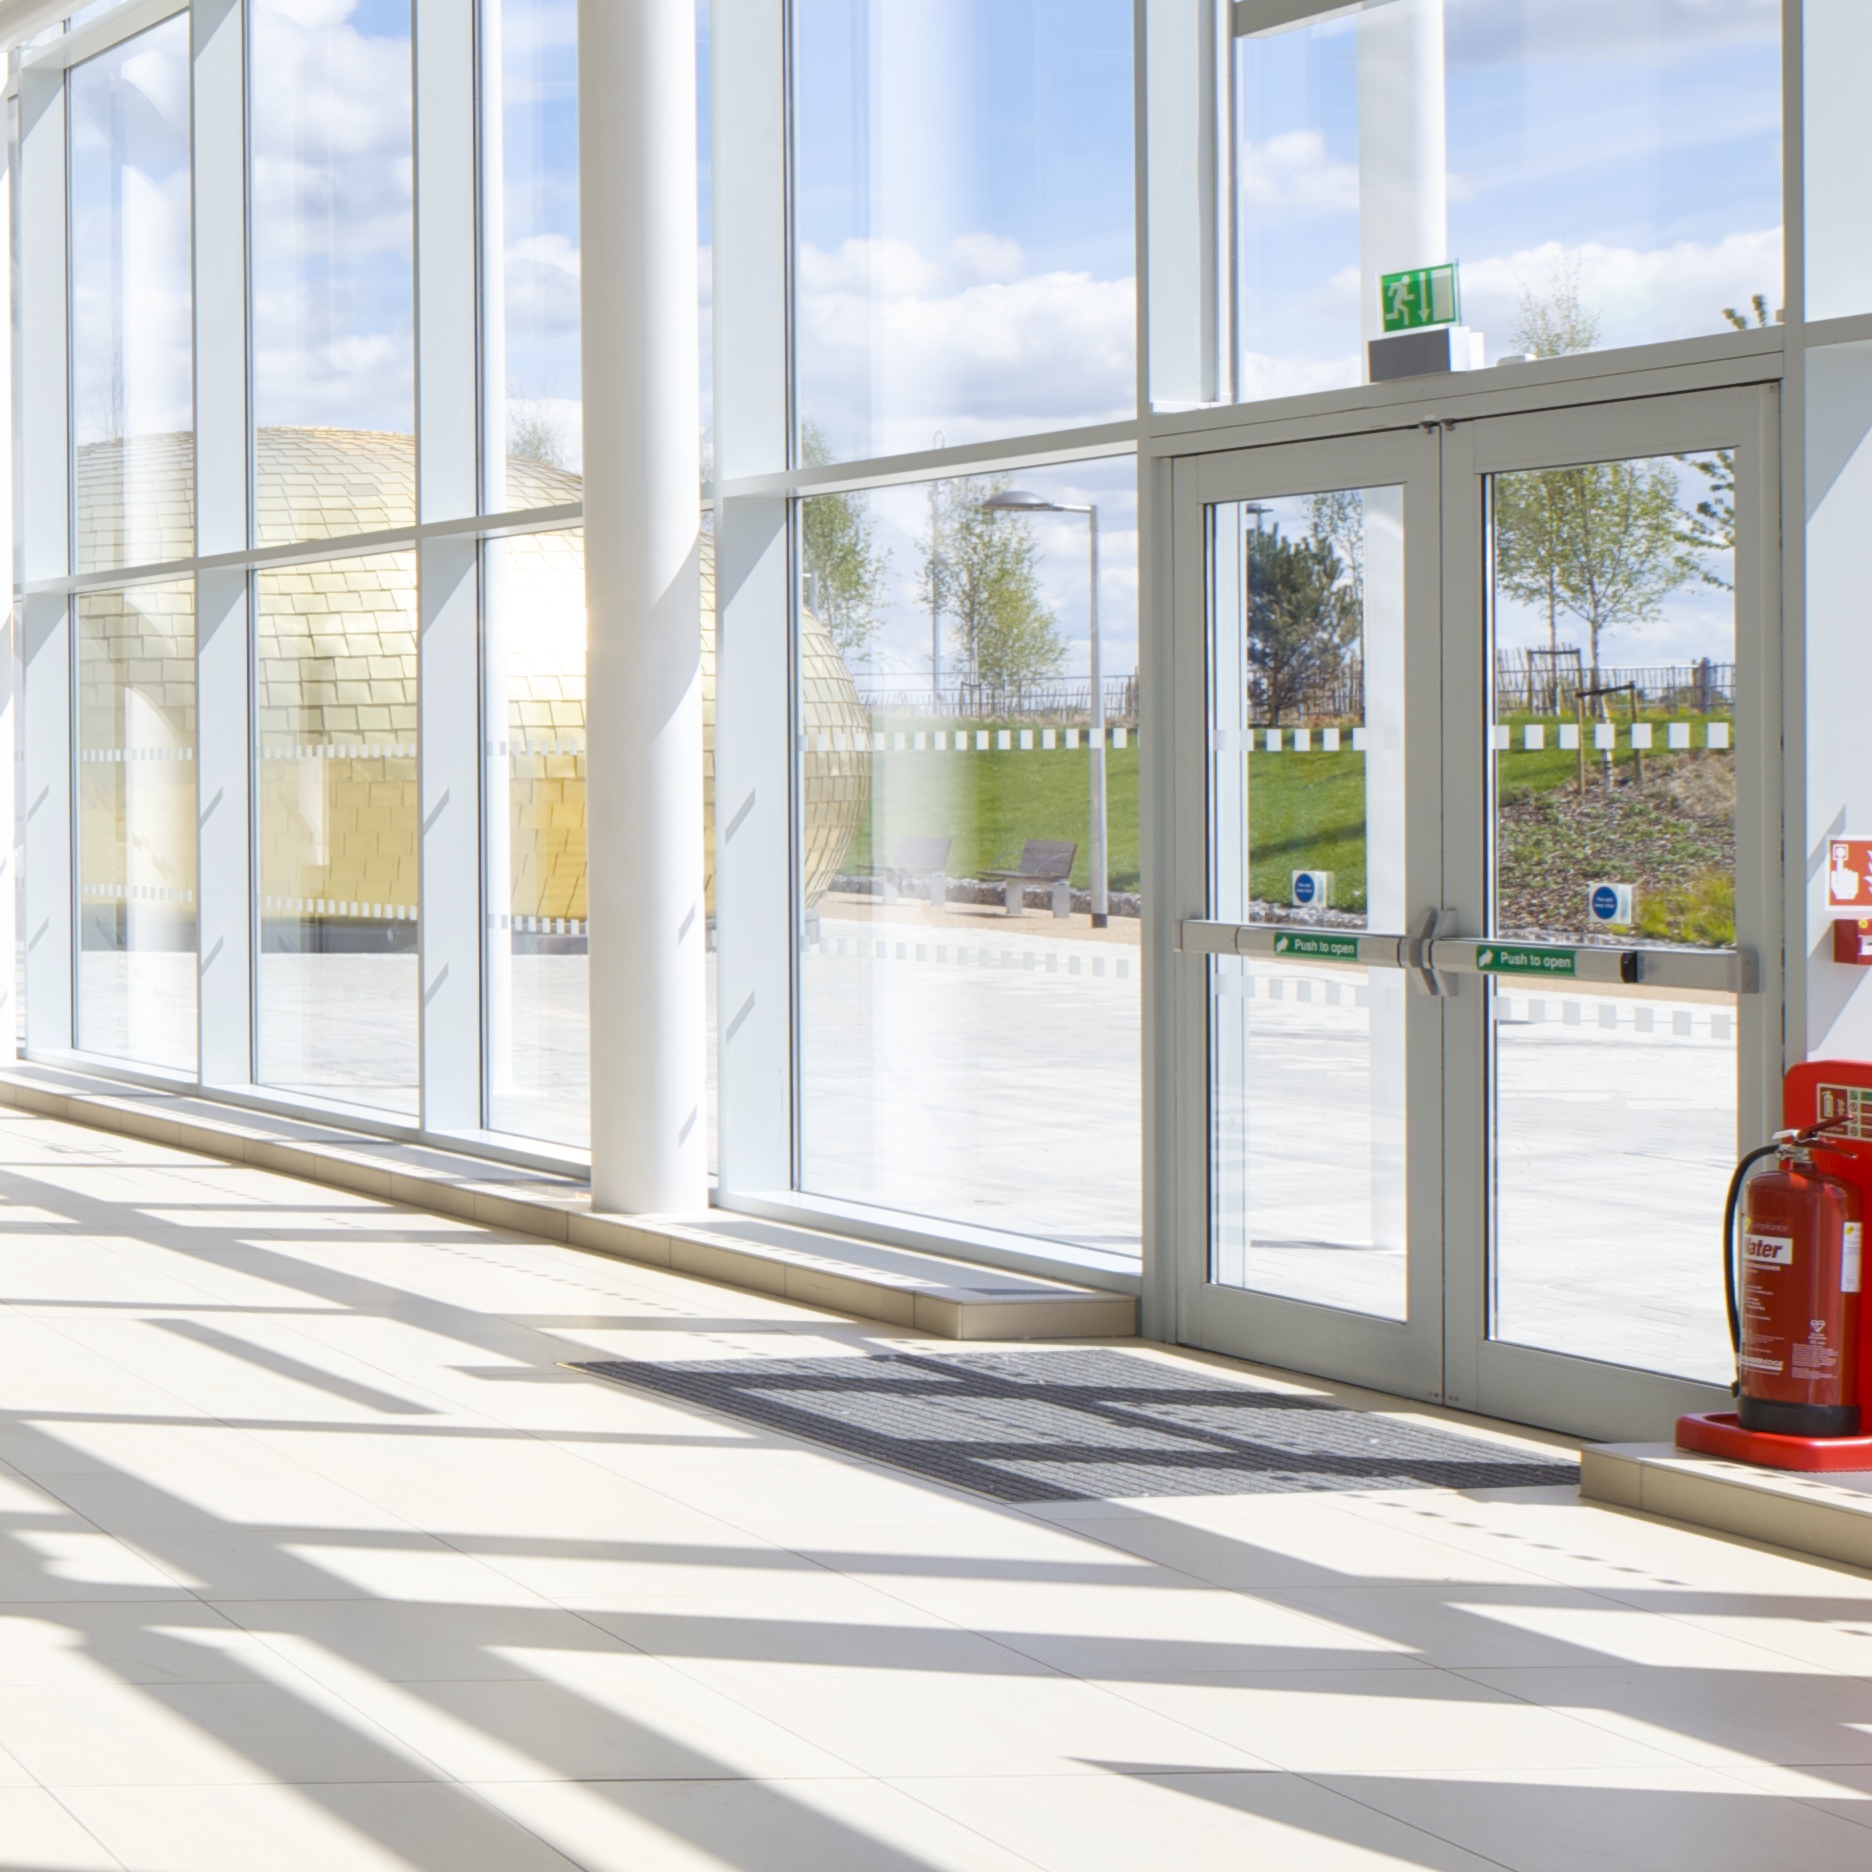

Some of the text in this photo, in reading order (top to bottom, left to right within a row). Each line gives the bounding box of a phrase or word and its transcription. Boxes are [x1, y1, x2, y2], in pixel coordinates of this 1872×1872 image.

[1294, 939, 1354, 956] Push to open
[1500, 952, 1571, 969] Push to open
